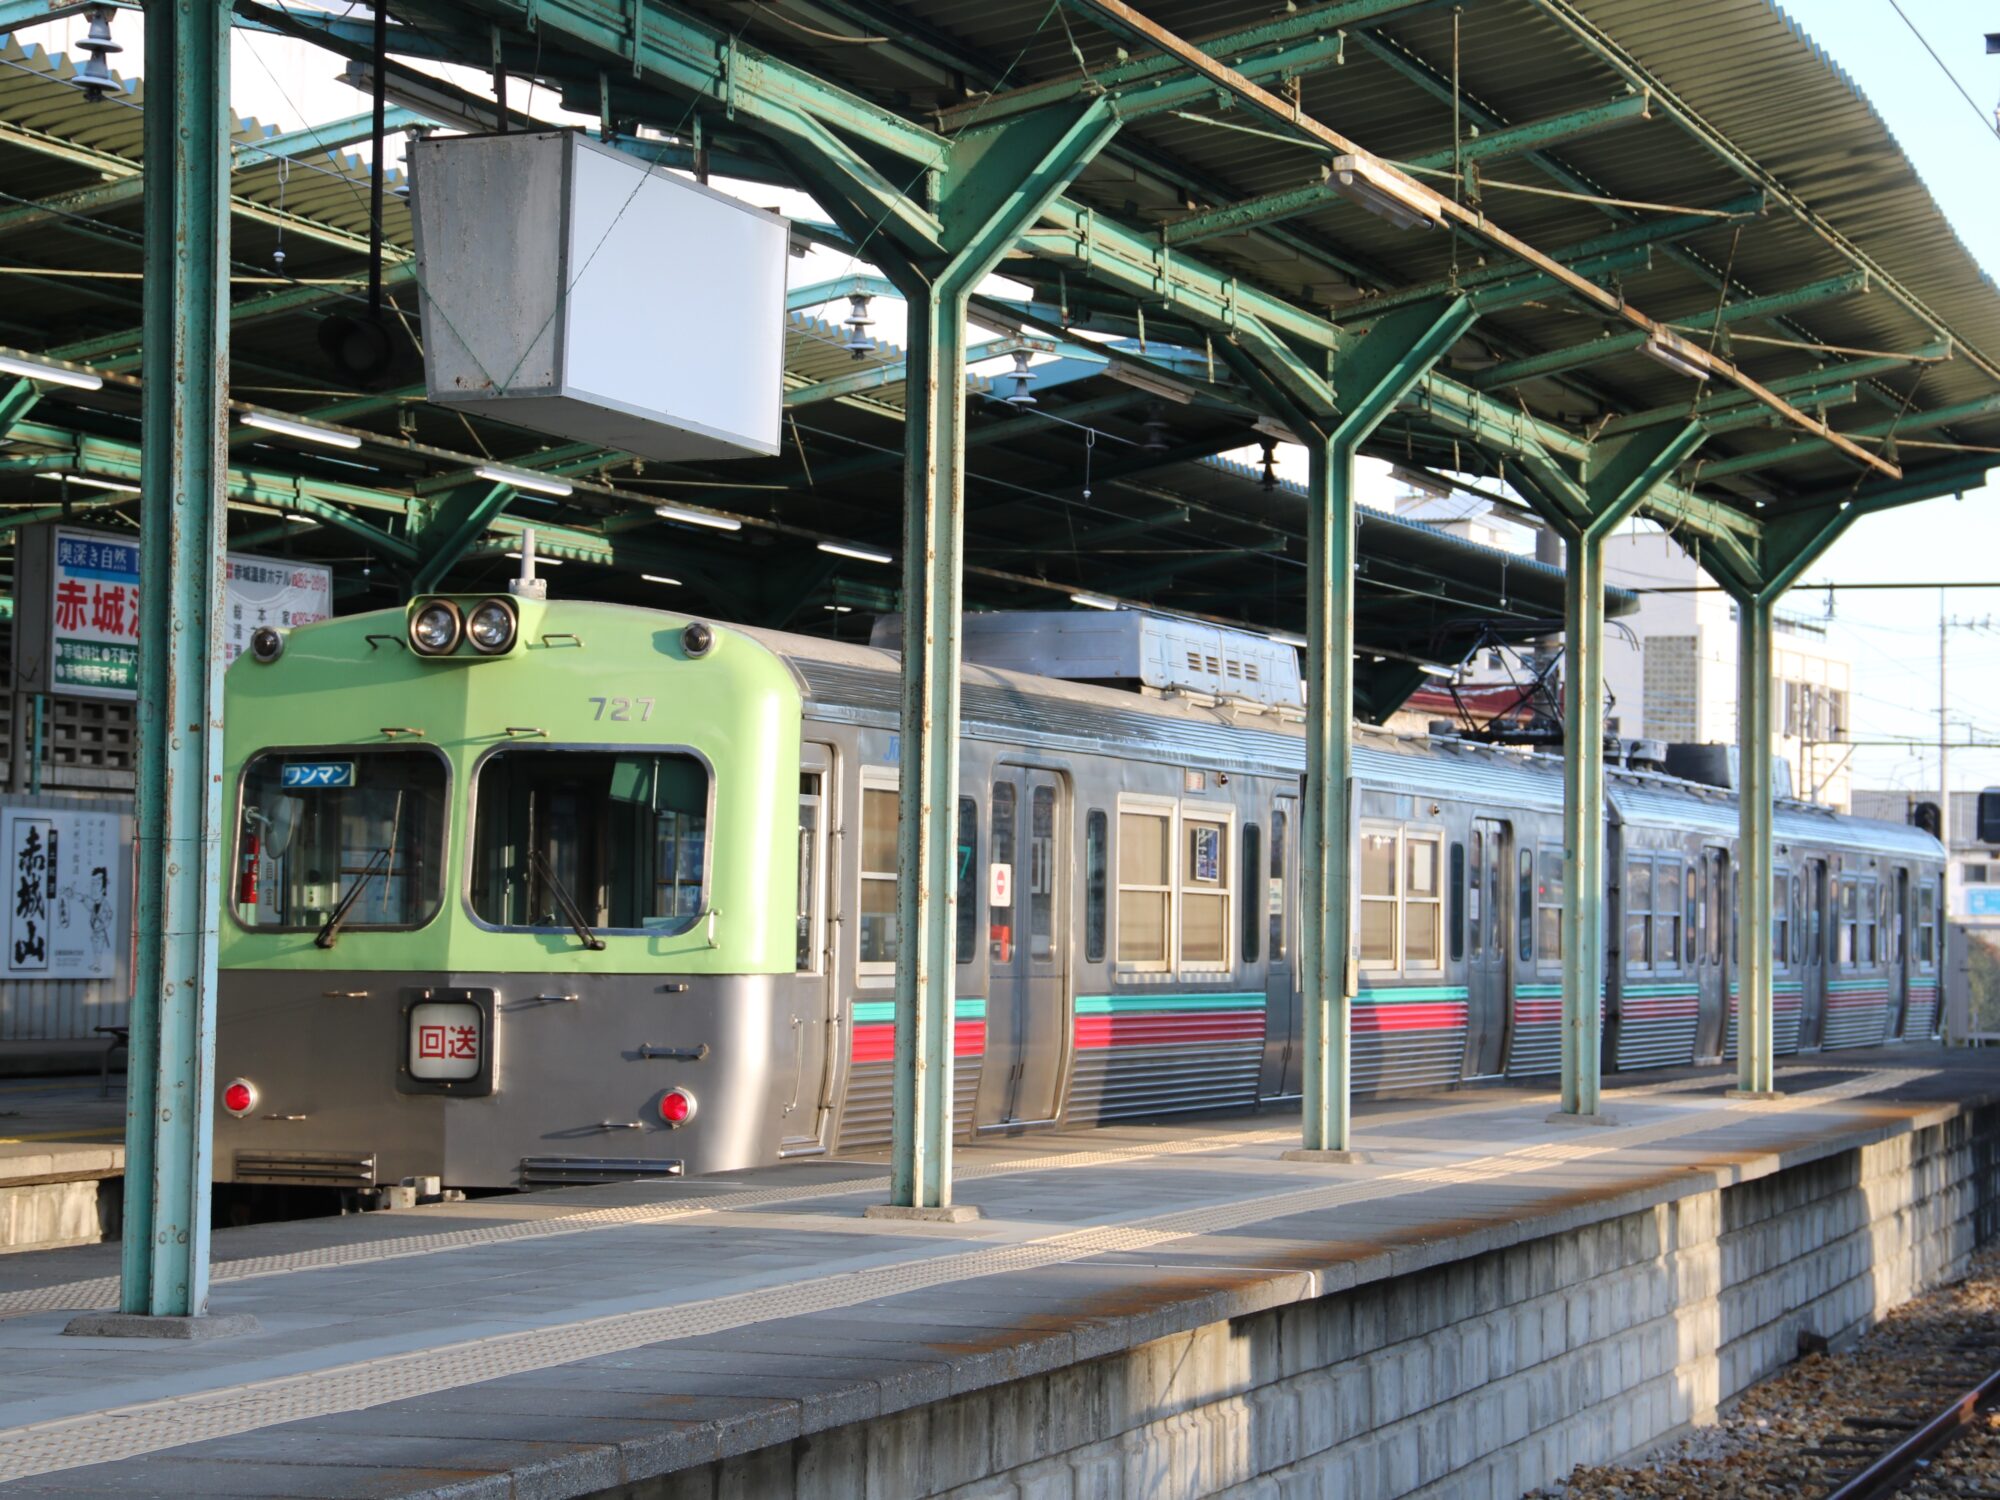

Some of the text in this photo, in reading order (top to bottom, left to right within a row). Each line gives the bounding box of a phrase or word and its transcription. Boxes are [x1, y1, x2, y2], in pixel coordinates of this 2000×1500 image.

[59, 541, 127, 571] 奥深き自然
[588, 697, 656, 721] 727
[285, 766, 350, 785] ワンマン
[14, 825, 46, 965] 赤城山
[419, 1025, 477, 1059] 回送
